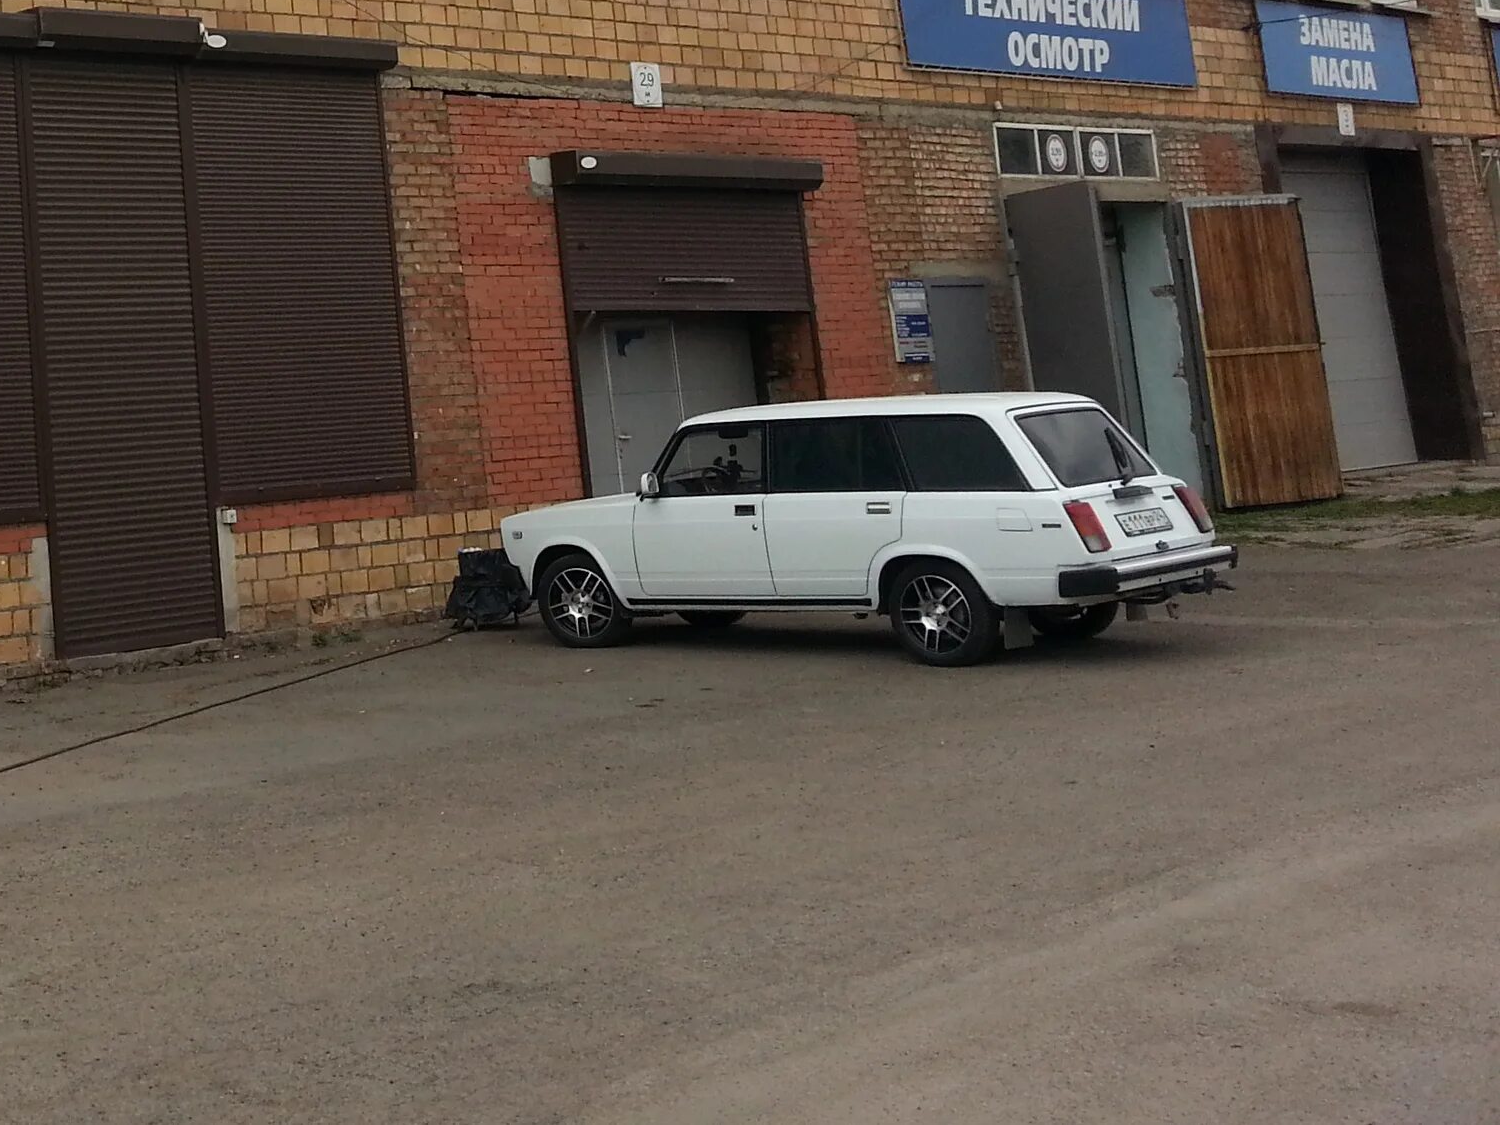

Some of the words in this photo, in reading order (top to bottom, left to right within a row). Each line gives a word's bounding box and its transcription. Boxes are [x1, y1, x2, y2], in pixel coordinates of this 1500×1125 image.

[1007, 31, 1110, 74] ОСМОТР
[1299, 14, 1375, 53] ЗАМЕНА
[1311, 54, 1377, 92] МАСЛА
